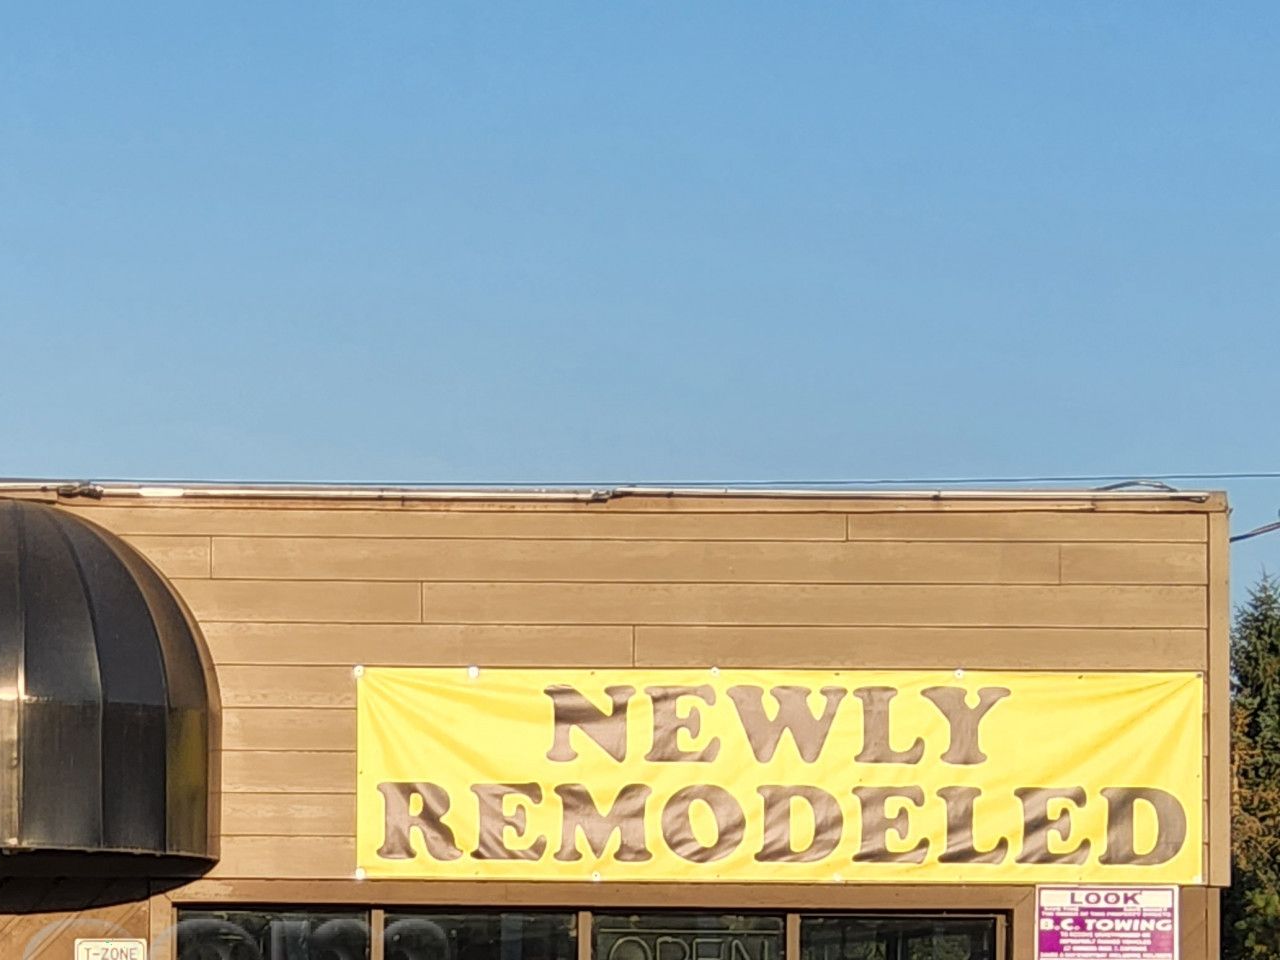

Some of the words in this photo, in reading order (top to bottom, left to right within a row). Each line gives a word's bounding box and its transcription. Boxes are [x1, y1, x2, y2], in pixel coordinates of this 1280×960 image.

[543, 684, 1012, 765] NEWLY
[376, 782, 1187, 866] REMODELED
[1070, 892, 1140, 905] LOOK
[1040, 918, 1080, 931] B.C.
[1084, 918, 1173, 931] TOWING
[84, 947, 138, 960] T-ZONE
